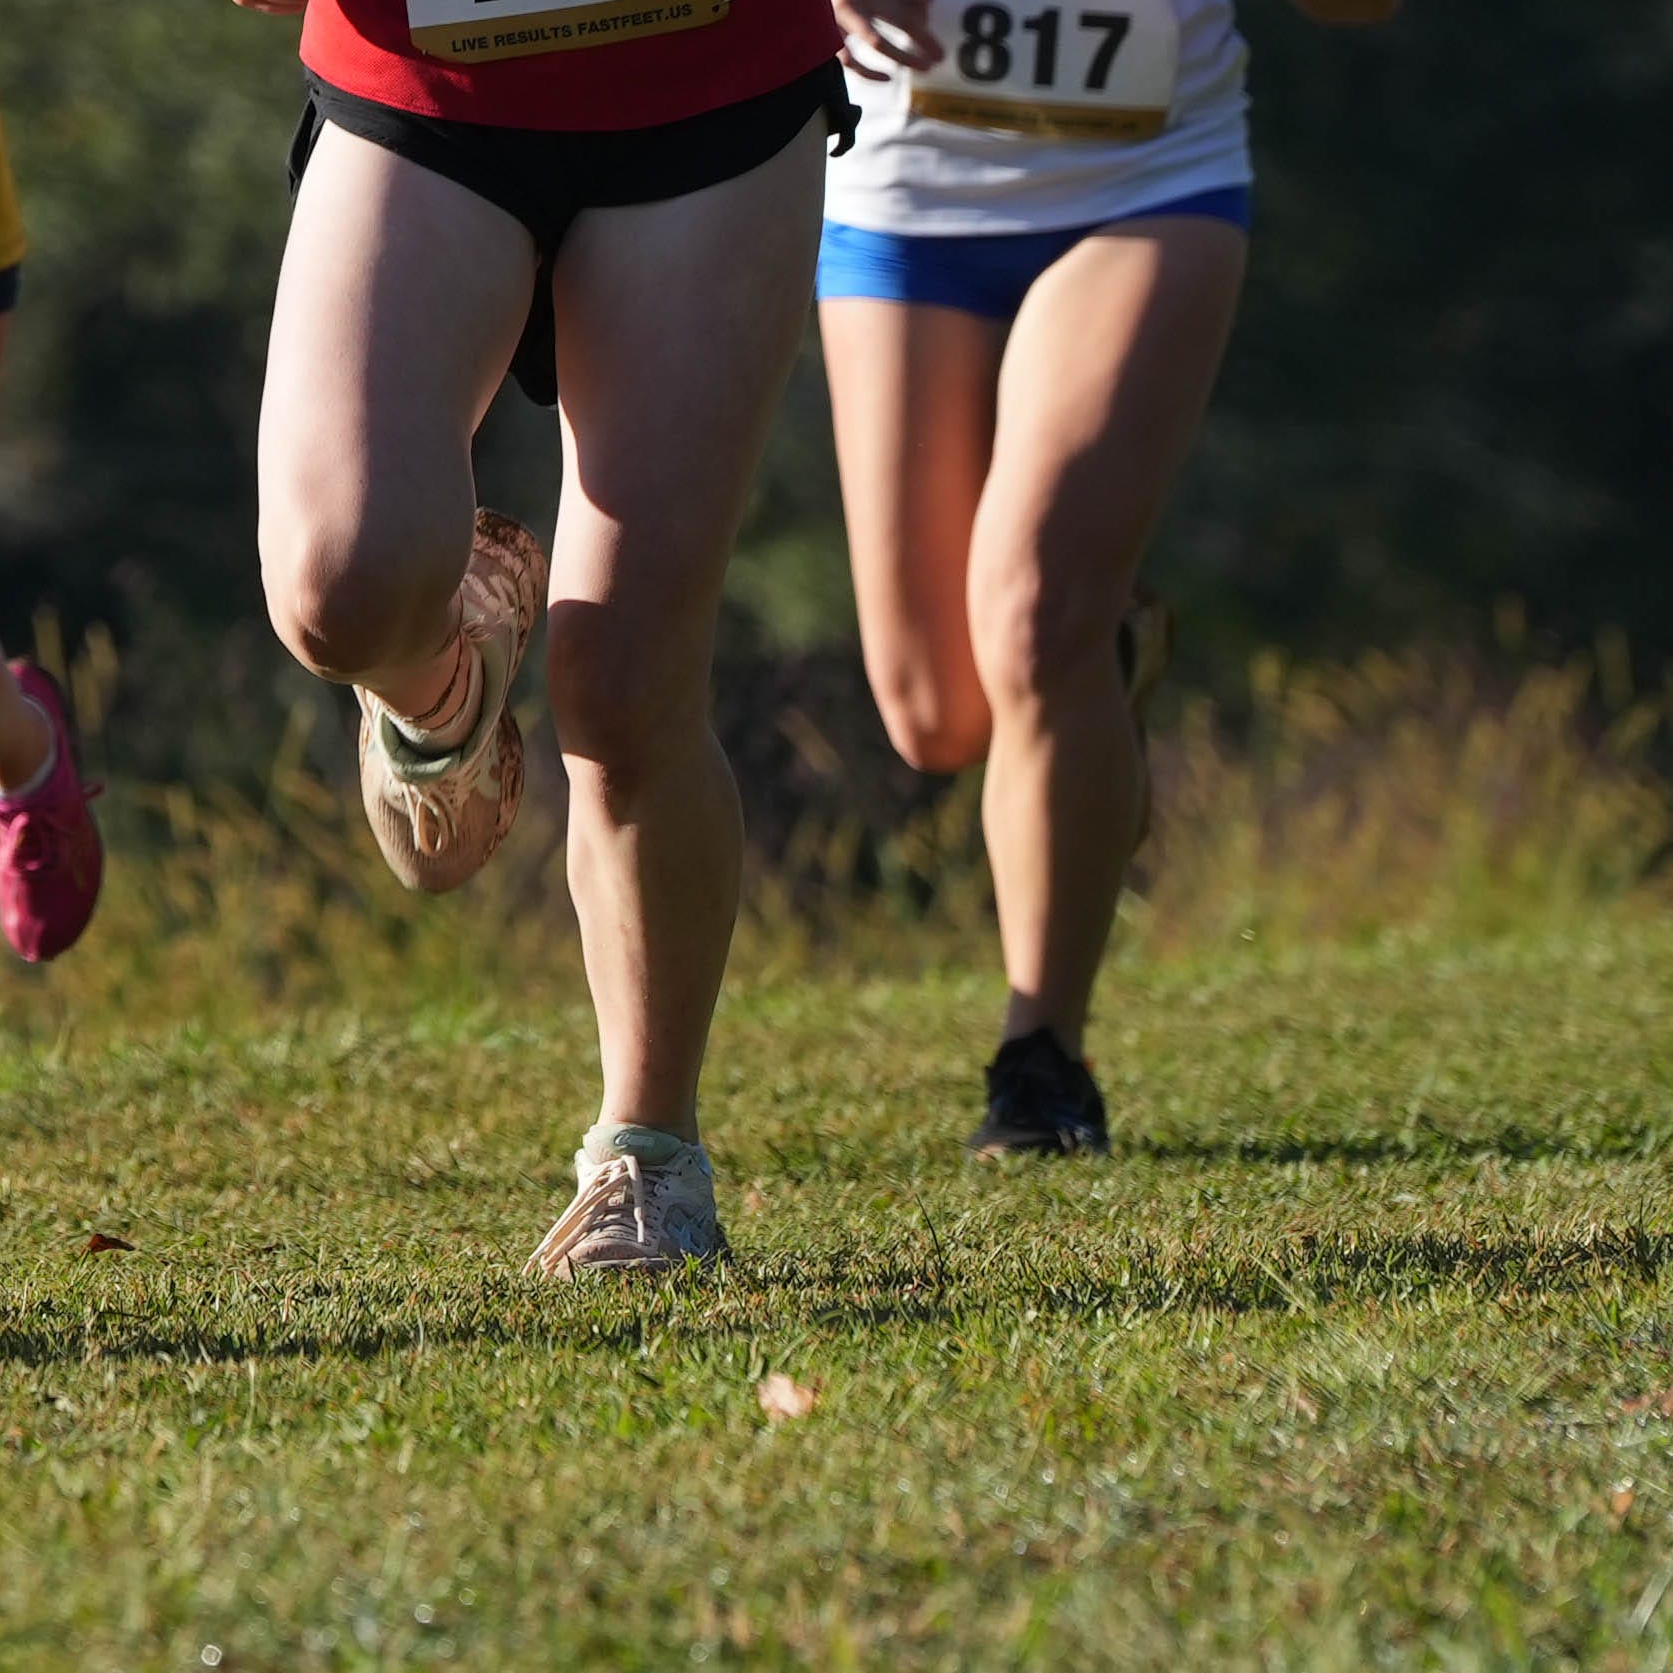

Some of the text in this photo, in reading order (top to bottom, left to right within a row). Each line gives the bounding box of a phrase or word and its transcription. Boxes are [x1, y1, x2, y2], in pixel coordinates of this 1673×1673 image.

[451, 3, 693, 53] LIVE RESULTS FASTFEET.US
[957, 0, 1131, 91] 817
